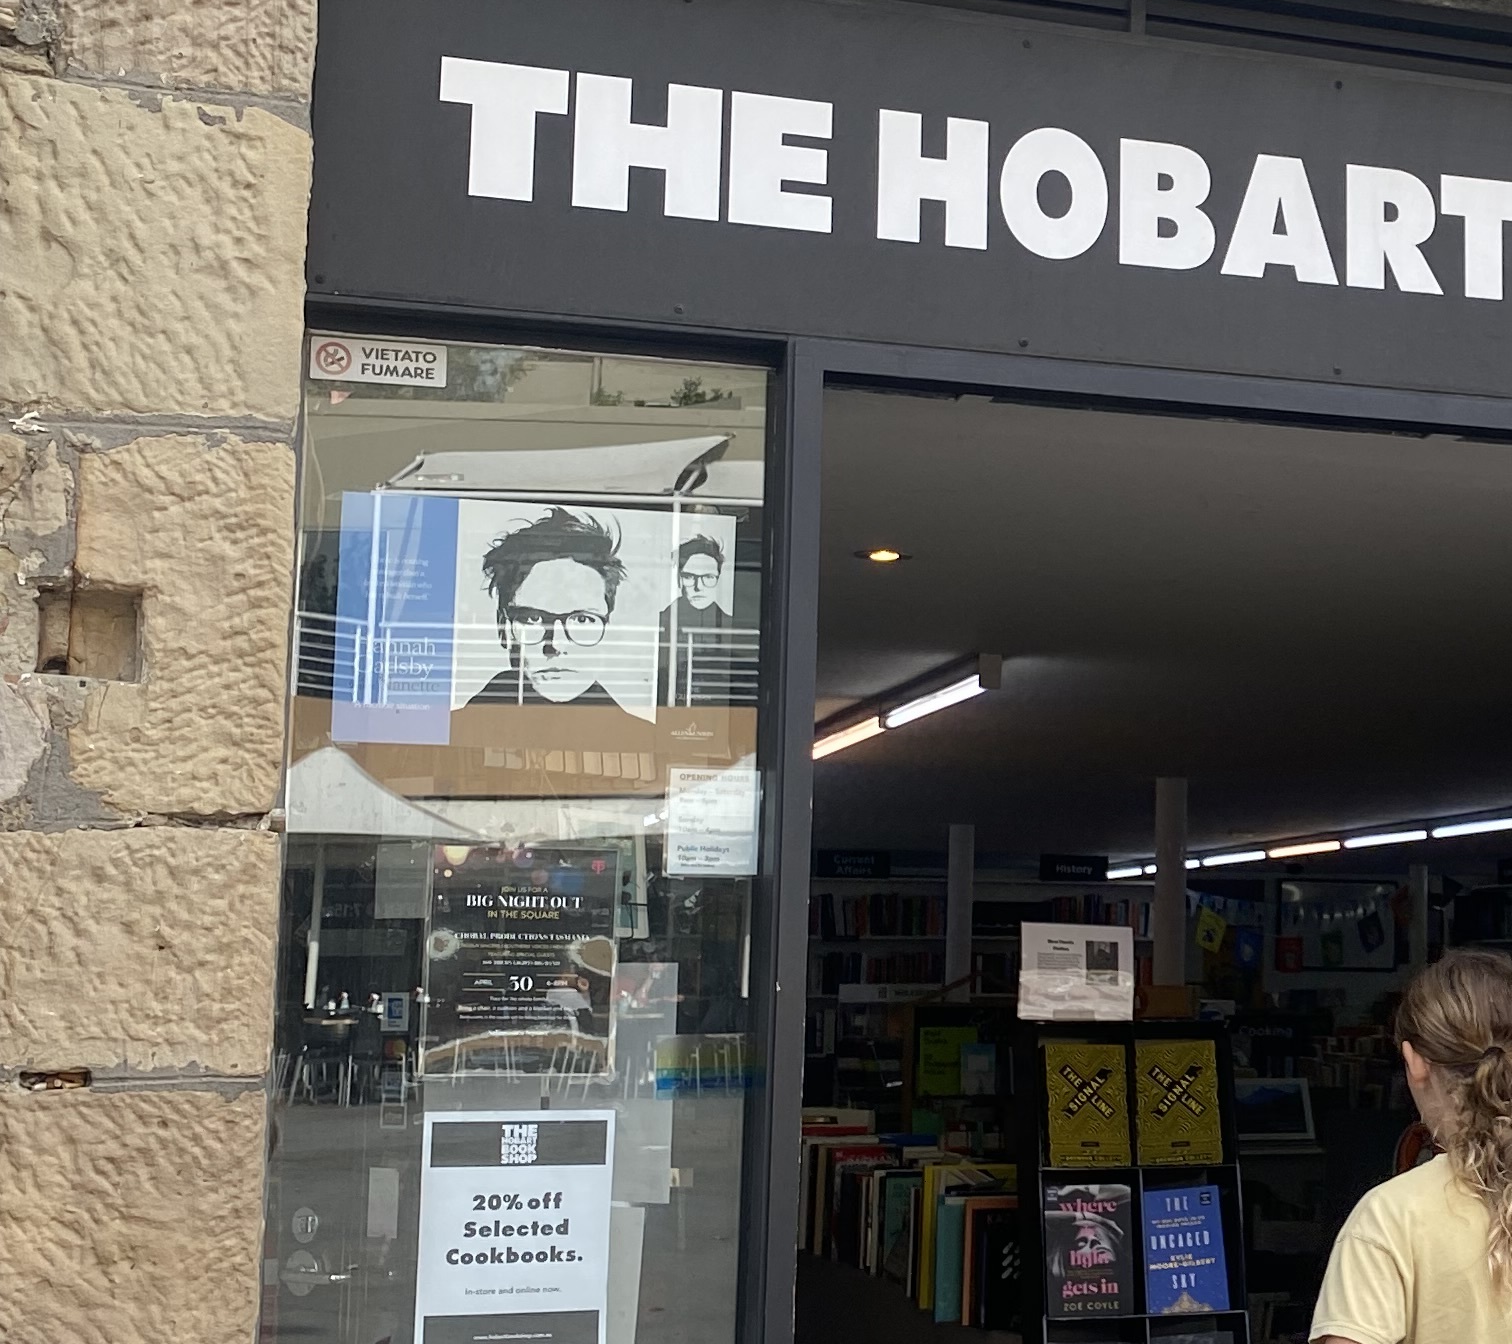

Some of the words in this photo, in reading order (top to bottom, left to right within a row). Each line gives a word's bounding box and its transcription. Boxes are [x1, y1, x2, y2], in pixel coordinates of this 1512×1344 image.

[439, 56, 834, 234] THE
[361, 346, 437, 364] VIETATO
[360, 363, 436, 380] FUMARE
[1055, 863, 1093, 875] History
[501, 886, 516, 894] JOIN
[527, 886, 542, 894] FOR
[542, 886, 549, 894] A
[466, 894, 494, 907] BIG
[498, 895, 549, 909] NIGHT
[550, 896, 583, 909] OUT
[487, 910, 498, 919] IN
[501, 910, 519, 919] THE
[520, 910, 560, 920] SQUARE
[508, 975, 534, 992] 30
[1238, 1023, 1293, 1040] Cooking
[1062, 1066, 1084, 1088] THE
[1151, 1066, 1173, 1088] THE
[1068, 1074, 1106, 1112] SIGNAL
[1158, 1072, 1196, 1112] SIGNAL
[1090, 1093, 1115, 1119] LINE
[1181, 1093, 1206, 1118] LINE
[501, 1123, 539, 1138] THE
[500, 1144, 537, 1155] BOOK
[500, 1154, 538, 1165] SHOP
[472, 1194, 523, 1211] 20%
[527, 1191, 563, 1210] off
[1058, 1198, 1118, 1214] where
[1165, 1195, 1189, 1213] THE
[463, 1218, 570, 1238] Selected
[1150, 1230, 1211, 1252] UNCAGED
[445, 1246, 583, 1265] Cookbooks.
[1062, 1280, 1098, 1299] gets
[1101, 1277, 1119, 1295] in
[1171, 1273, 1196, 1290] SKY
[464, 1287, 496, 1296] In-store
[498, 1287, 514, 1295] and
[515, 1286, 541, 1294] online
[542, 1286, 562, 1294] now.
